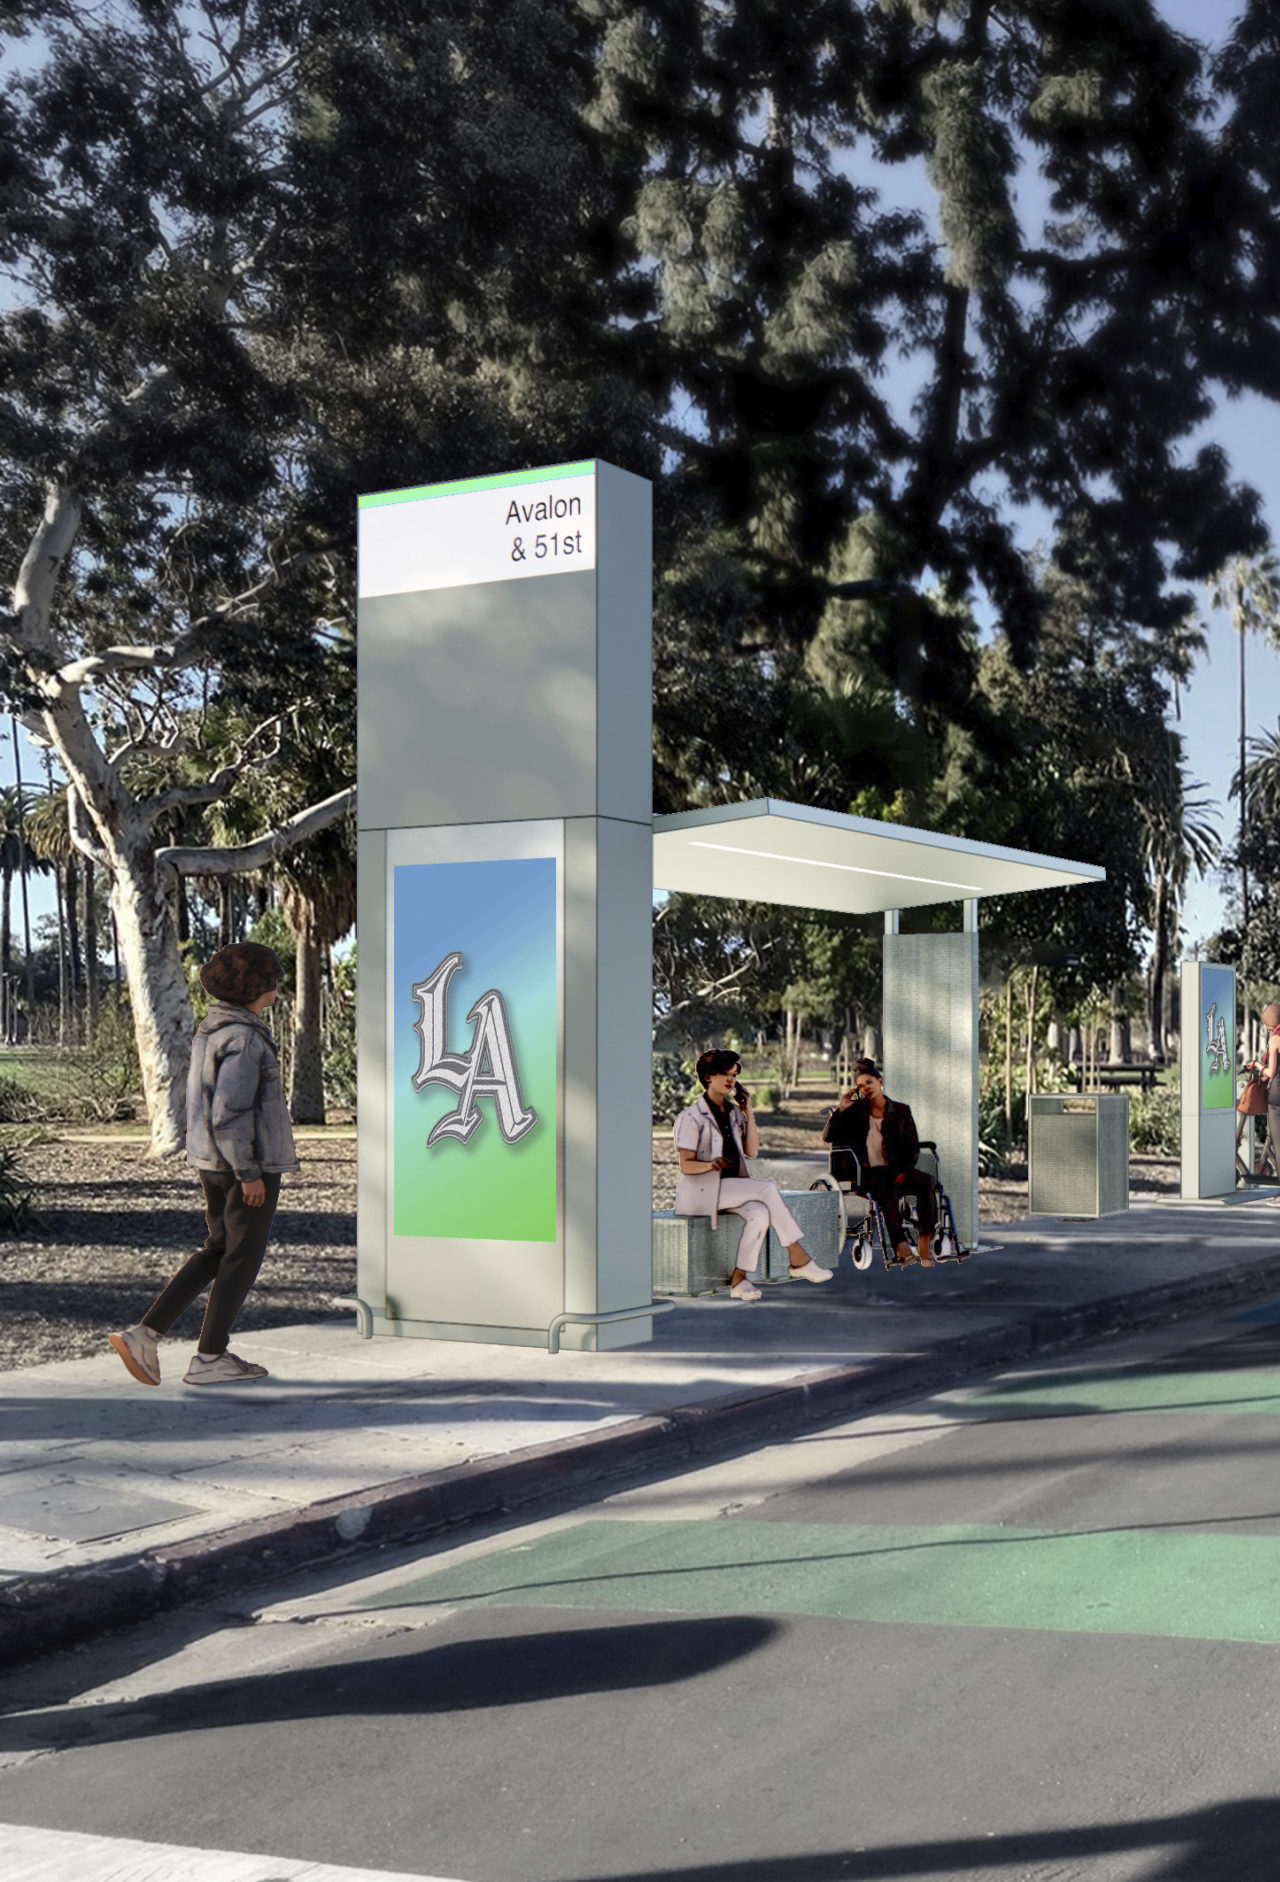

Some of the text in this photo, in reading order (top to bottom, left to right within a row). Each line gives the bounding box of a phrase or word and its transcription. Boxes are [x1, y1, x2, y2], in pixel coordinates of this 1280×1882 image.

[505, 494, 581, 525] Avalon
[511, 530, 582, 562] & 51st
[411, 951, 538, 1149] LA
[1206, 1002, 1230, 1074] LA
